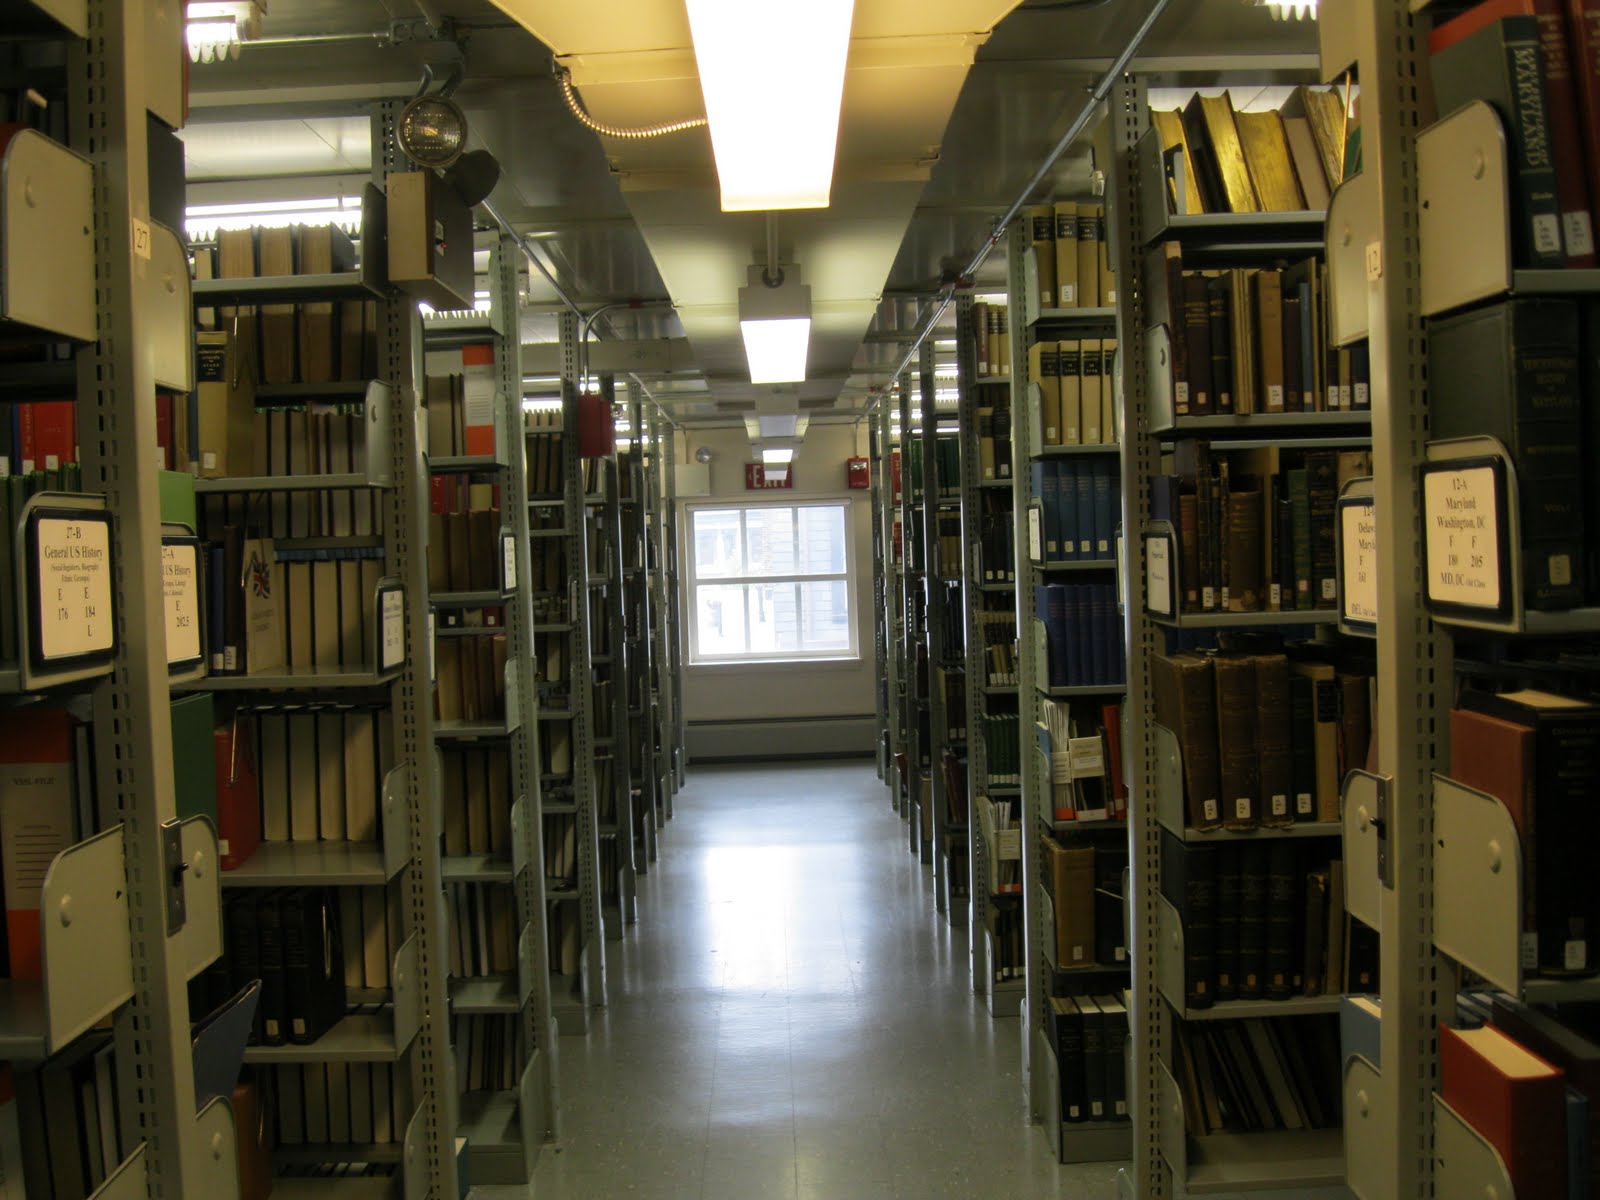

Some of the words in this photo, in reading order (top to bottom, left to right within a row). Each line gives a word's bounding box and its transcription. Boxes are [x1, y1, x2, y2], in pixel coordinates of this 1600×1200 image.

[136, 227, 148, 251] 27
[1445, 497, 1476, 512] Maryland
[66, 526, 82, 539] 27-B
[44, 544, 68, 559] General
[69, 545, 81, 559] US
[82, 545, 103, 561] History
[174, 564, 191, 579] History
[58, 607, 69, 621] 176
[85, 605, 96, 619] 184
